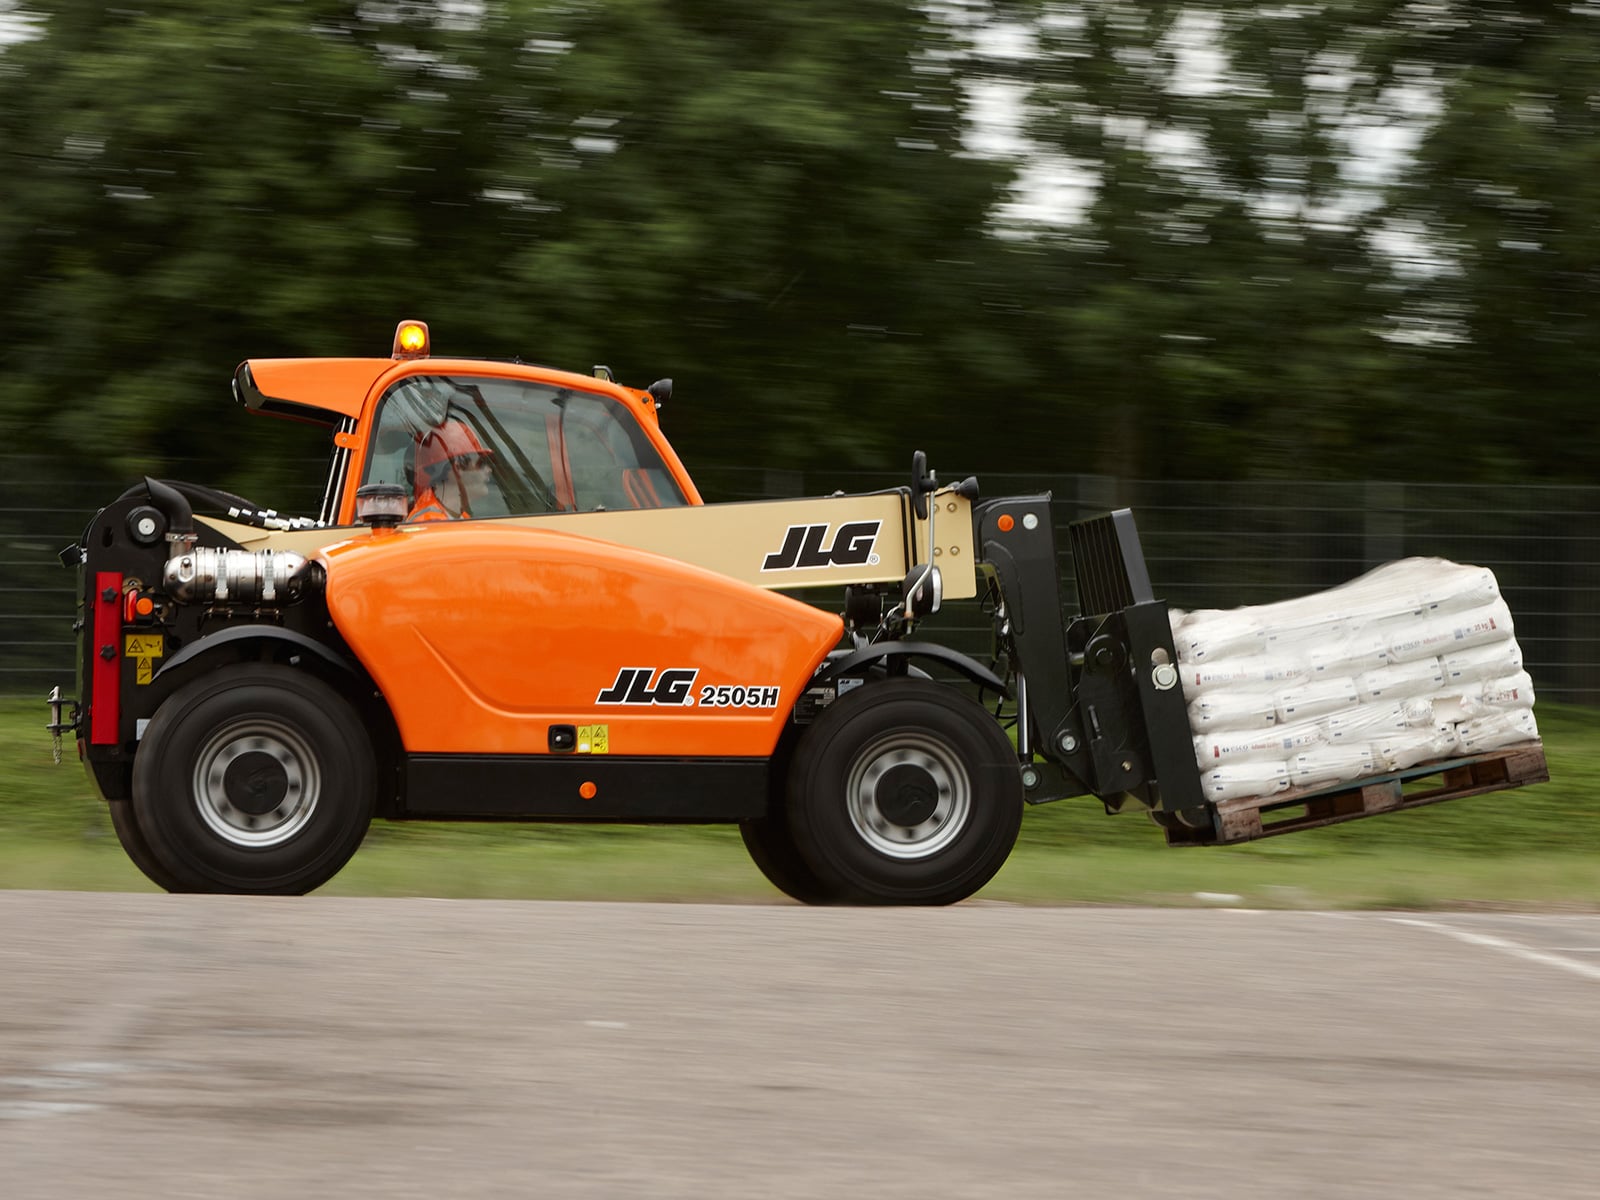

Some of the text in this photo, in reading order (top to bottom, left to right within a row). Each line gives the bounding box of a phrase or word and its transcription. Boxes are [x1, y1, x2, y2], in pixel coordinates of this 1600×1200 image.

[761, 520, 882, 571] JLG
[596, 668, 780, 706] JLG 2505H
